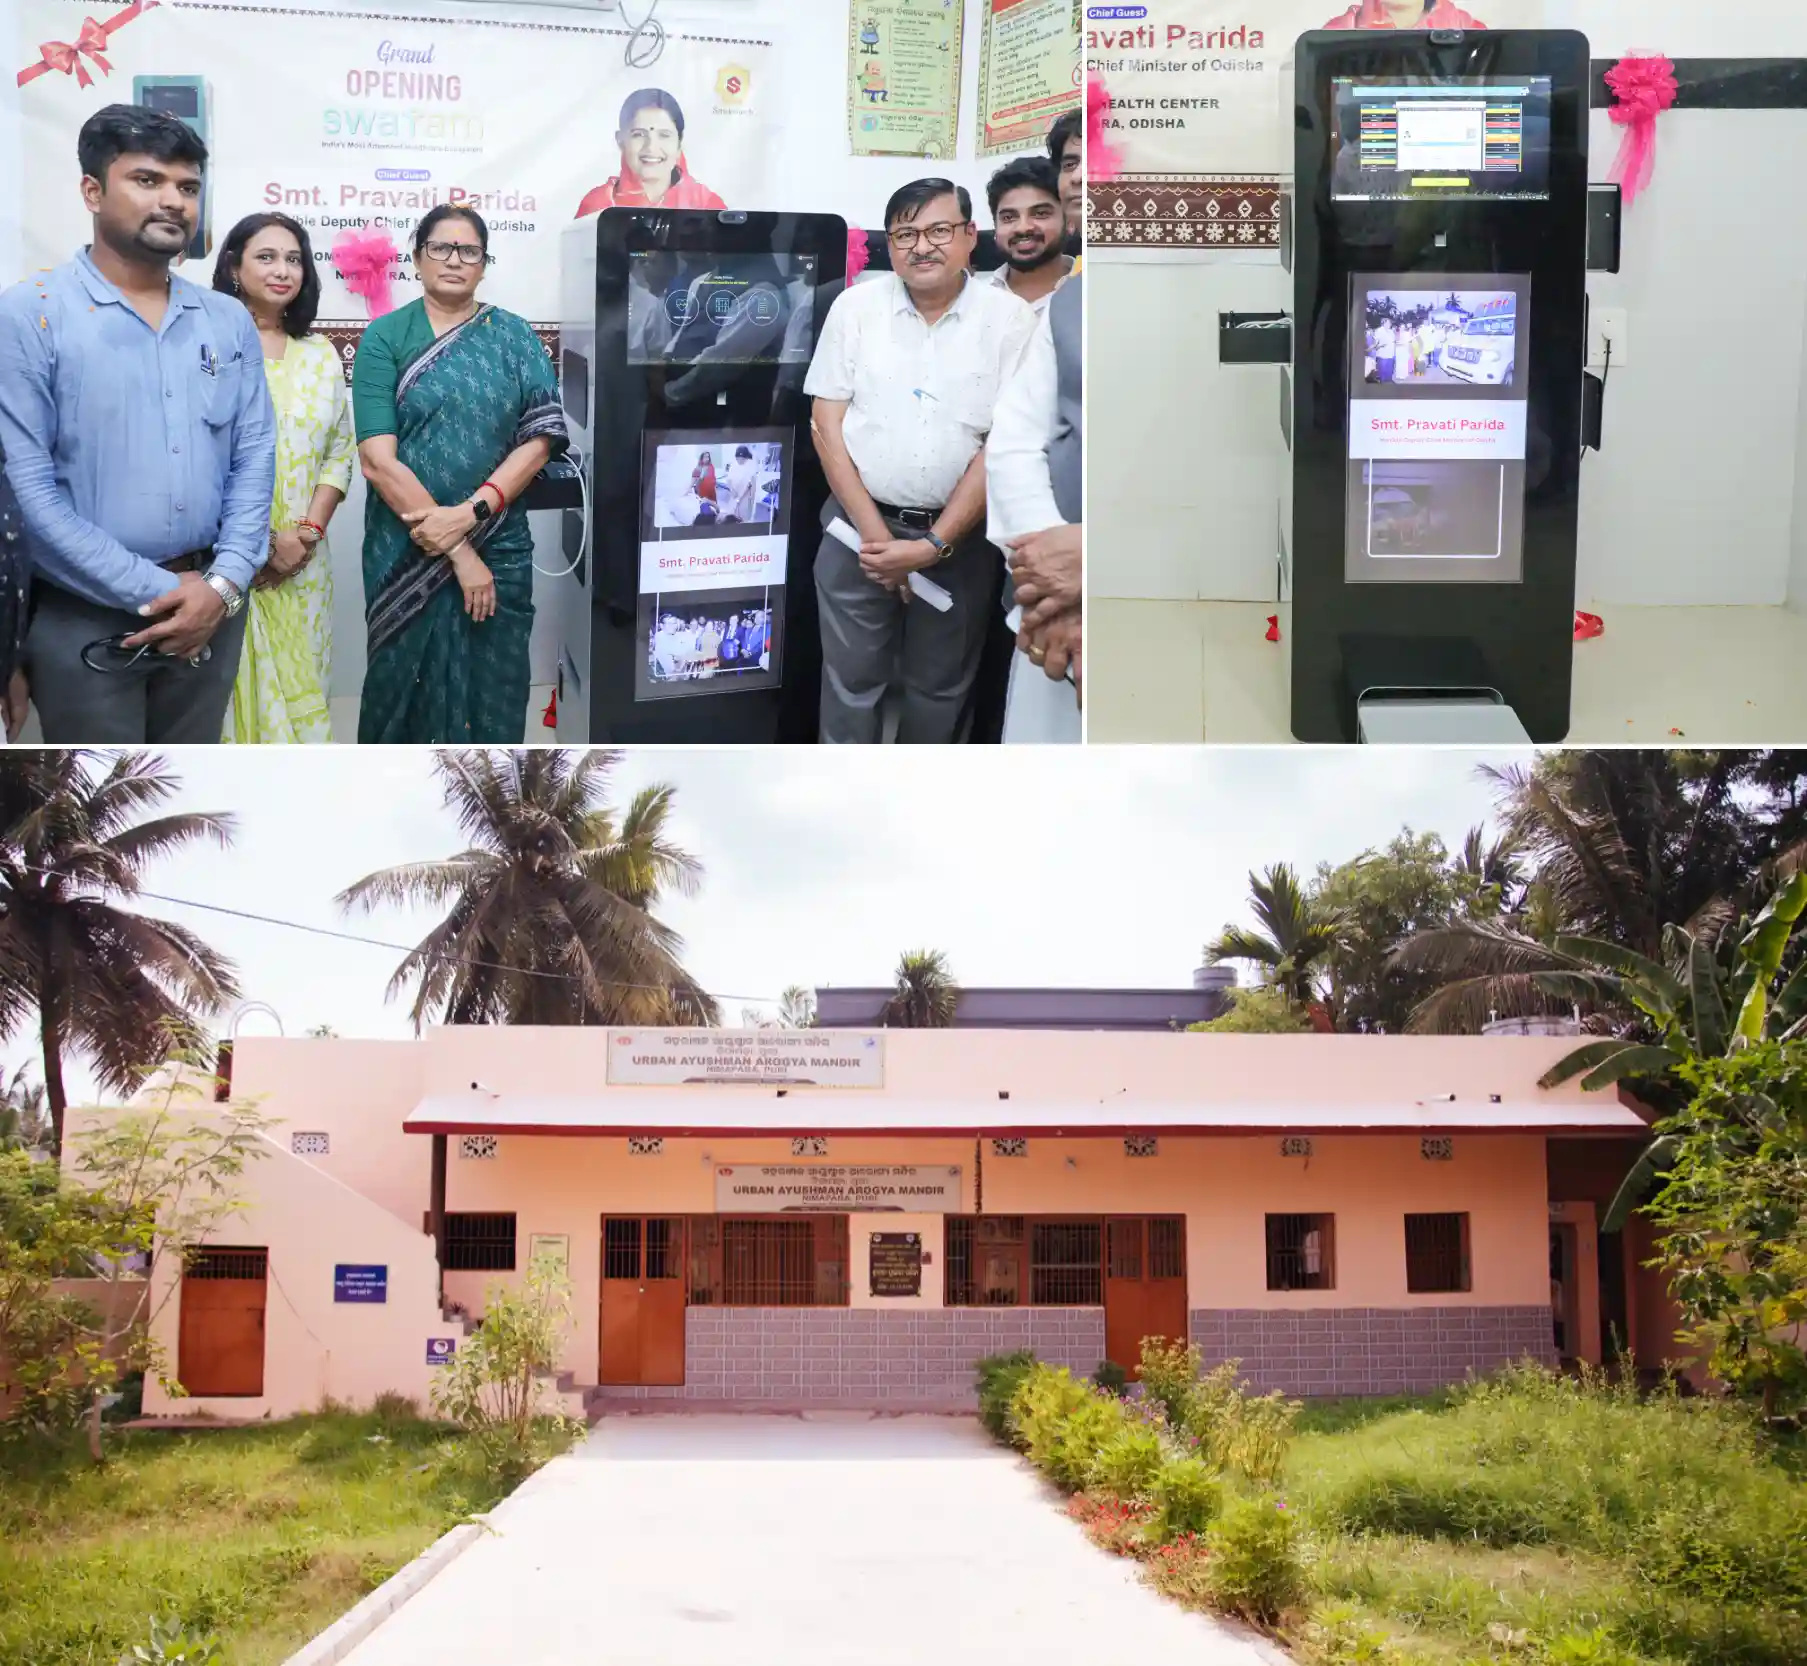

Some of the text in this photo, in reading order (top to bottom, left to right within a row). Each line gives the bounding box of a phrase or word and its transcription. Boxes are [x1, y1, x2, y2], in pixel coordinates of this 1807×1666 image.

[1089, 8, 1145, 18] Chief Guest
[1087, 24, 1154, 49] avati
[1166, 24, 1264, 49] Parida
[377, 39, 435, 65] Grand
[1087, 59, 1264, 72] Chief Minister of Odisha
[346, 69, 461, 101] OPENING
[1160, 98, 1220, 109] CENTER
[1129, 118, 1186, 129] ODISHA
[377, 171, 428, 180] Chief Guest
[264, 182, 536, 212] Smt. Pravati Parida
[321, 216, 369, 231] Deputy
[374, 216, 411, 229] Chief
[489, 220, 535, 232] Odisha
[1371, 419, 1505, 431] Smt. Pravati Parida
[659, 552, 770, 568] Smt. Pravati Parida
[632, 1055, 861, 1068] URBAN AYUSHMAN AROGYA MANDIR
[733, 1186, 945, 1195] URBAN AYUSHMAN AROGYA MANDIR
